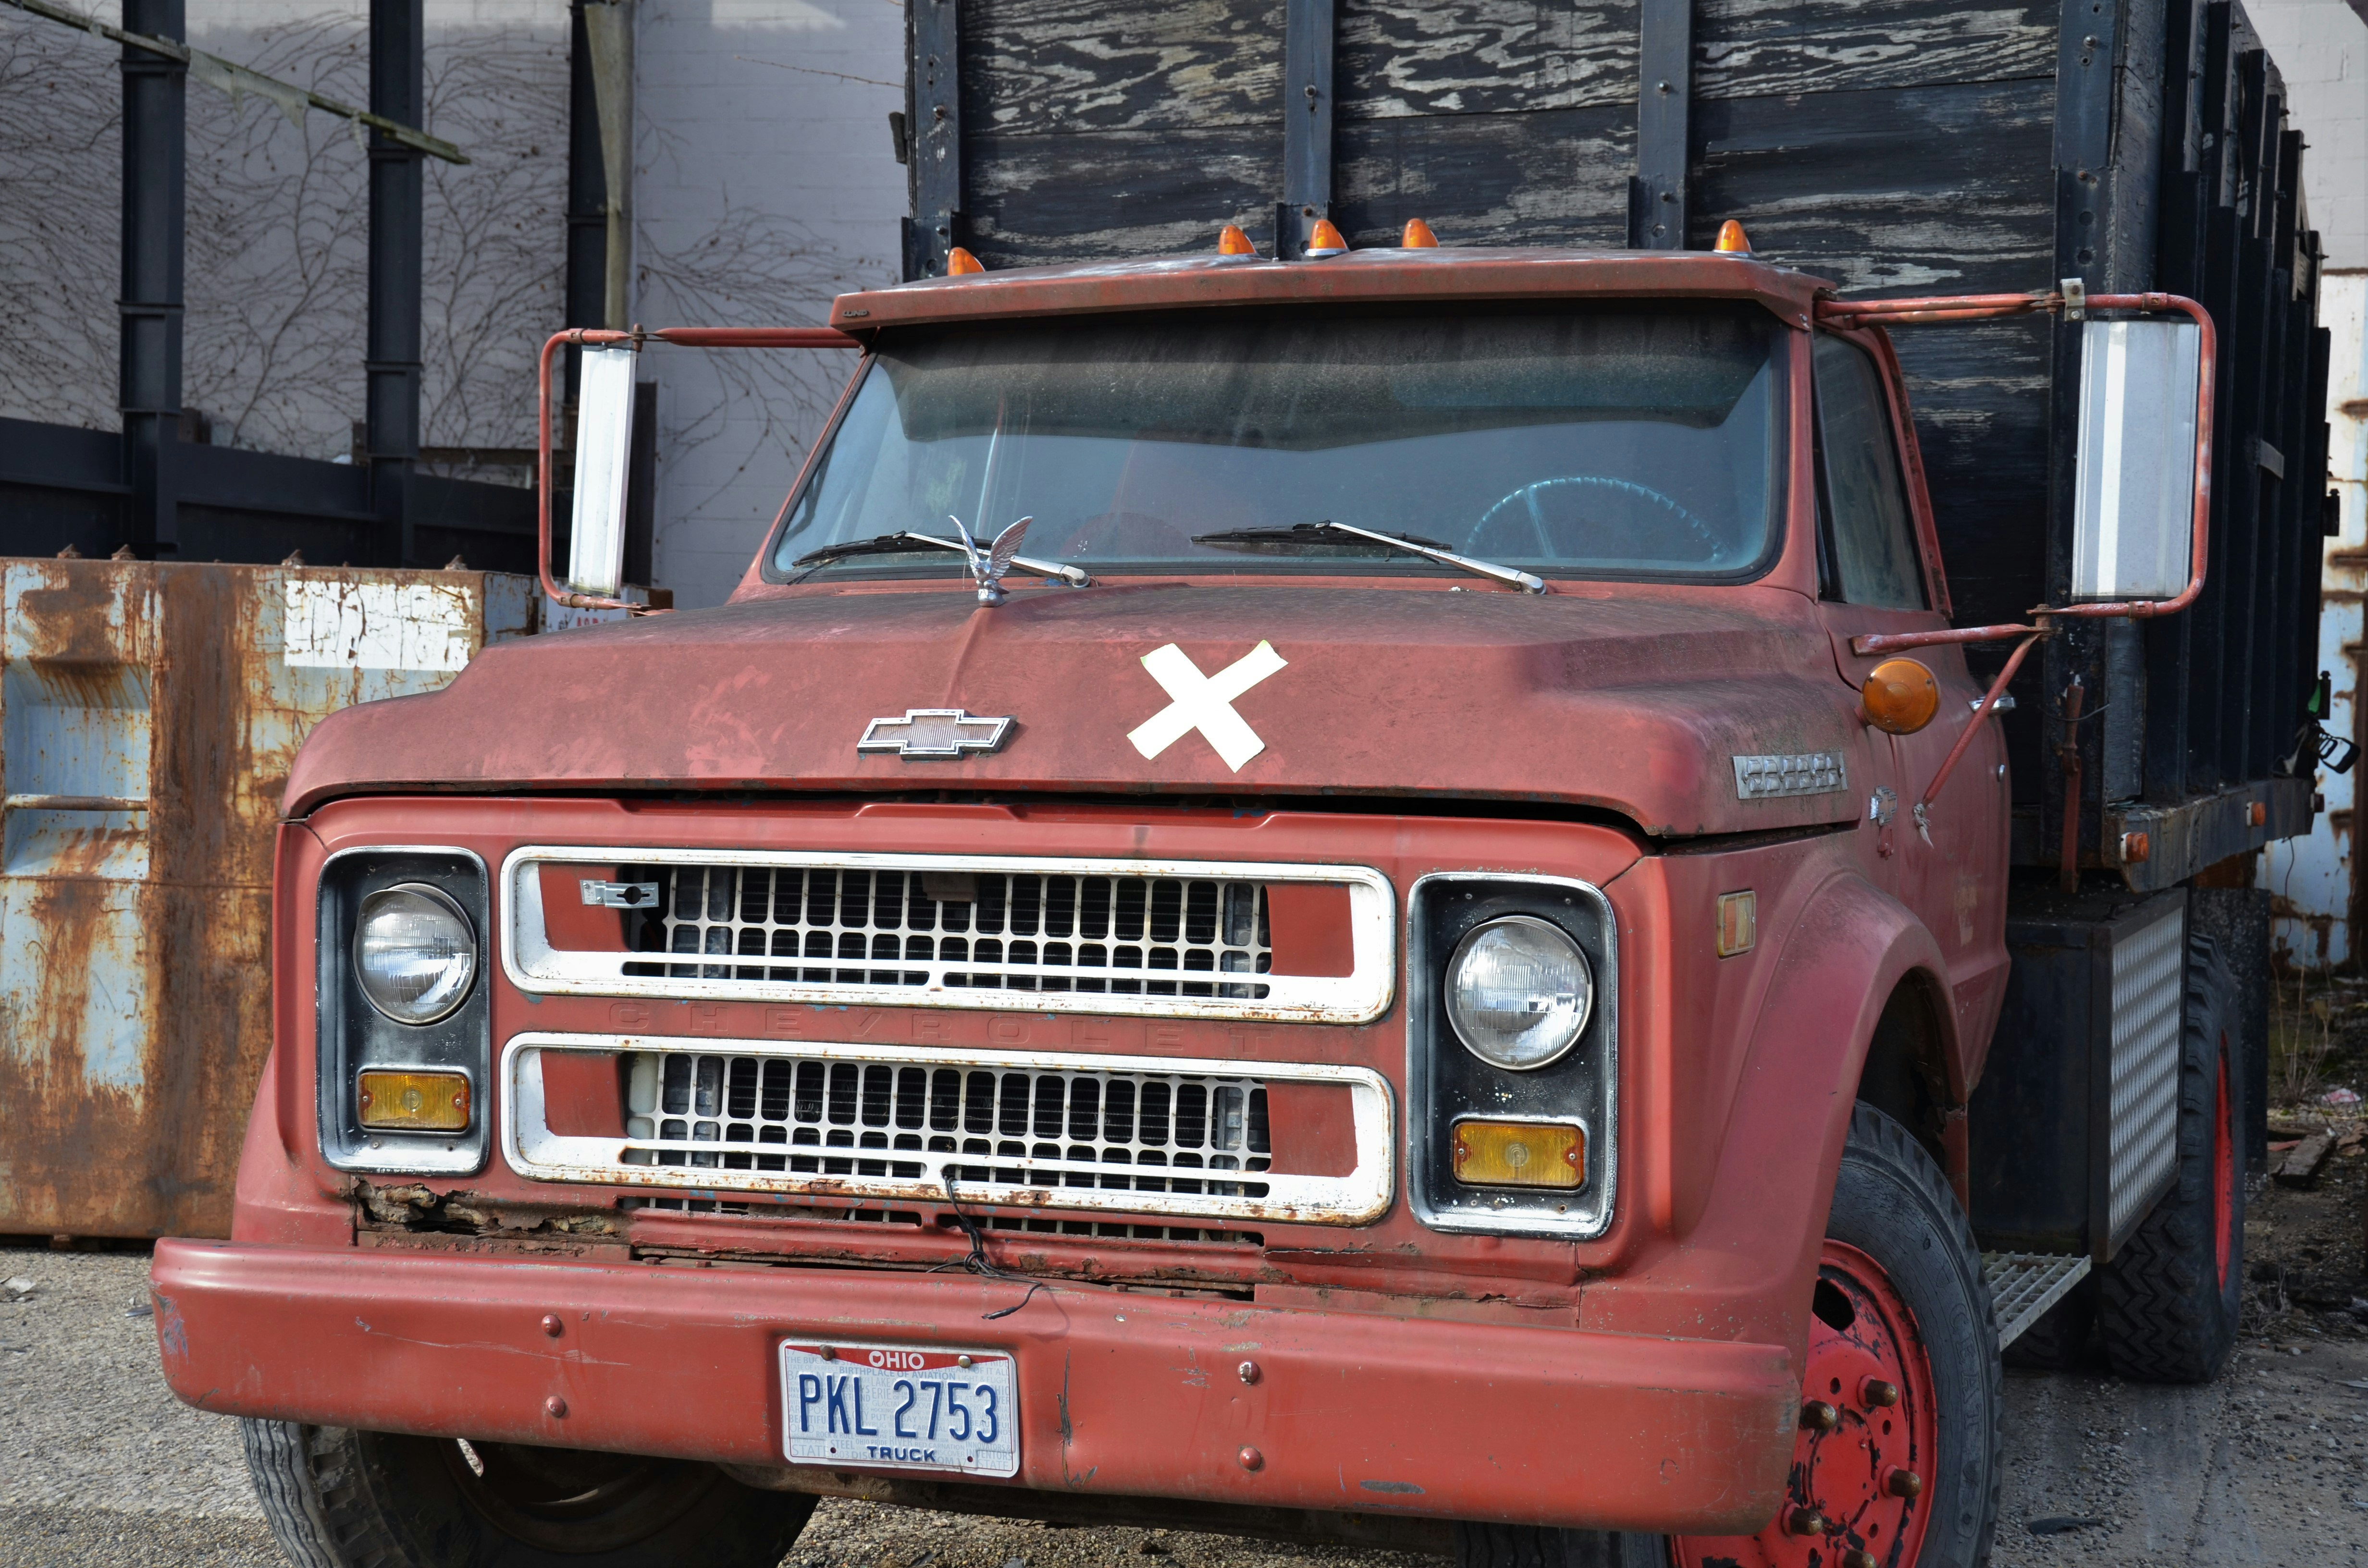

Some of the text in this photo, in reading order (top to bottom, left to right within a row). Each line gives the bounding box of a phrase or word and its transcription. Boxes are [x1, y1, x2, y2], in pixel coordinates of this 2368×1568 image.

[609, 1003, 1272, 1054] CHEVROLET
[869, 1351, 925, 1370] OHIO
[1949, 1302, 1982, 1435] CEAT
[839, 1366, 895, 1377] BIRTHPLACE
[911, 1371, 956, 1380] AVIATION
[799, 1373, 997, 1444] PKL 2753
[830, 1439, 855, 1449] STEEL
[866, 1446, 936, 1462] TRUCK
